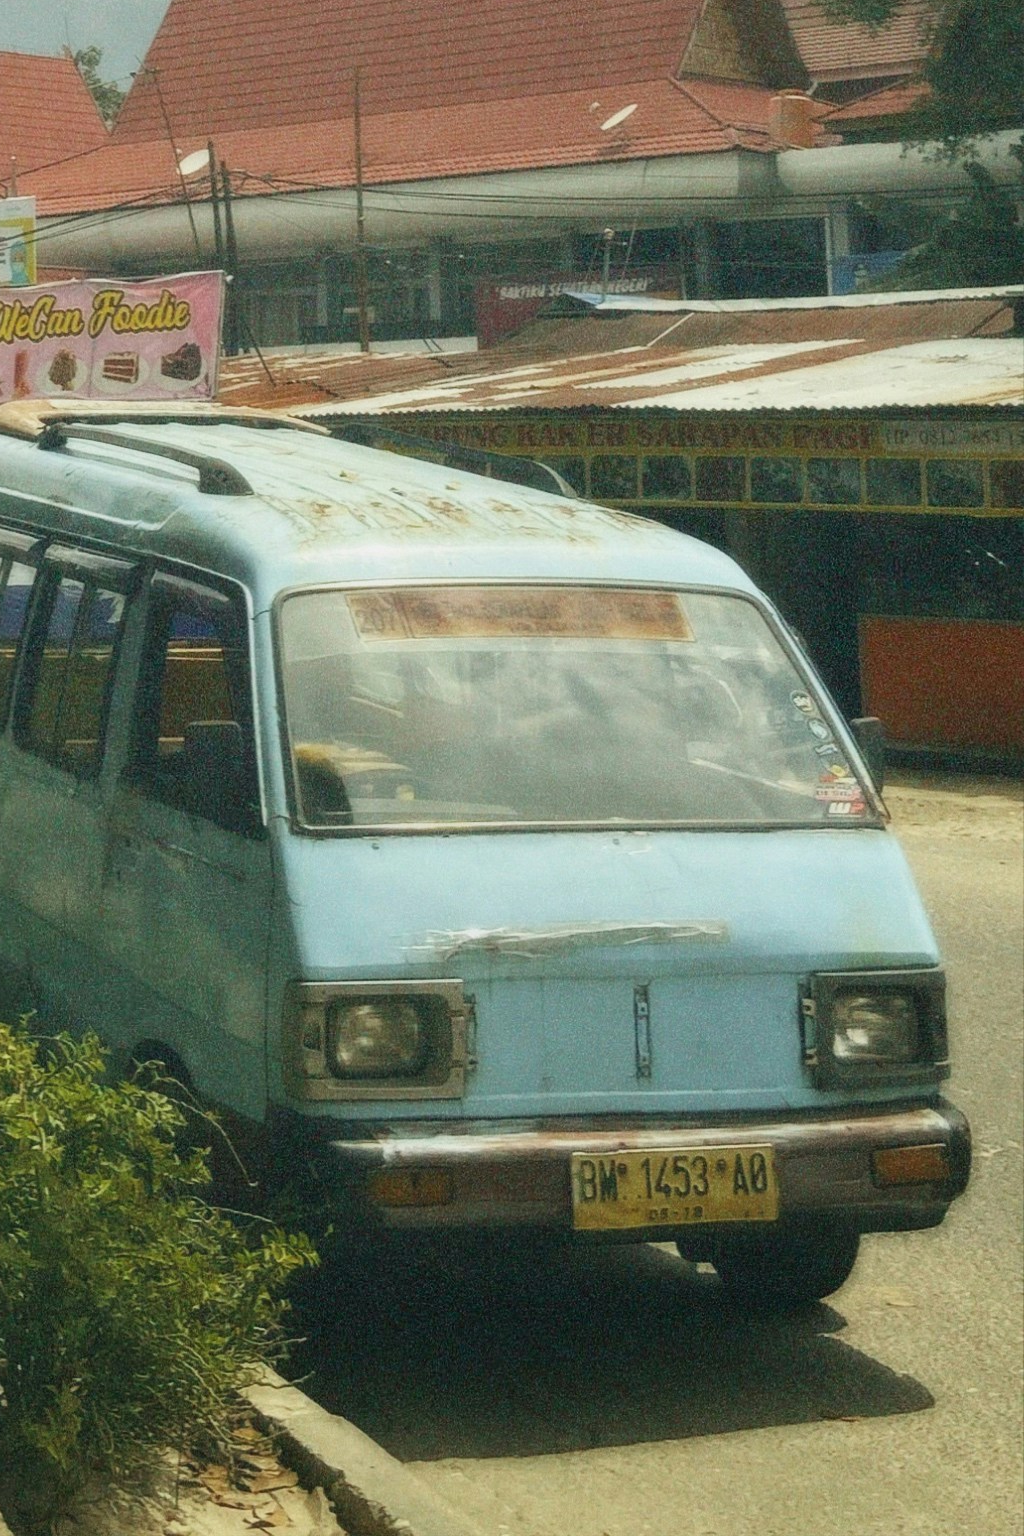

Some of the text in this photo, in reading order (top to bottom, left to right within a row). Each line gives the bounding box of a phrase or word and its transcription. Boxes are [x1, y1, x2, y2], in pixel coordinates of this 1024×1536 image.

[88, 289, 191, 338] Foodie
[578, 1160, 619, 1202] BM
[640, 1155, 709, 1199] 1453
